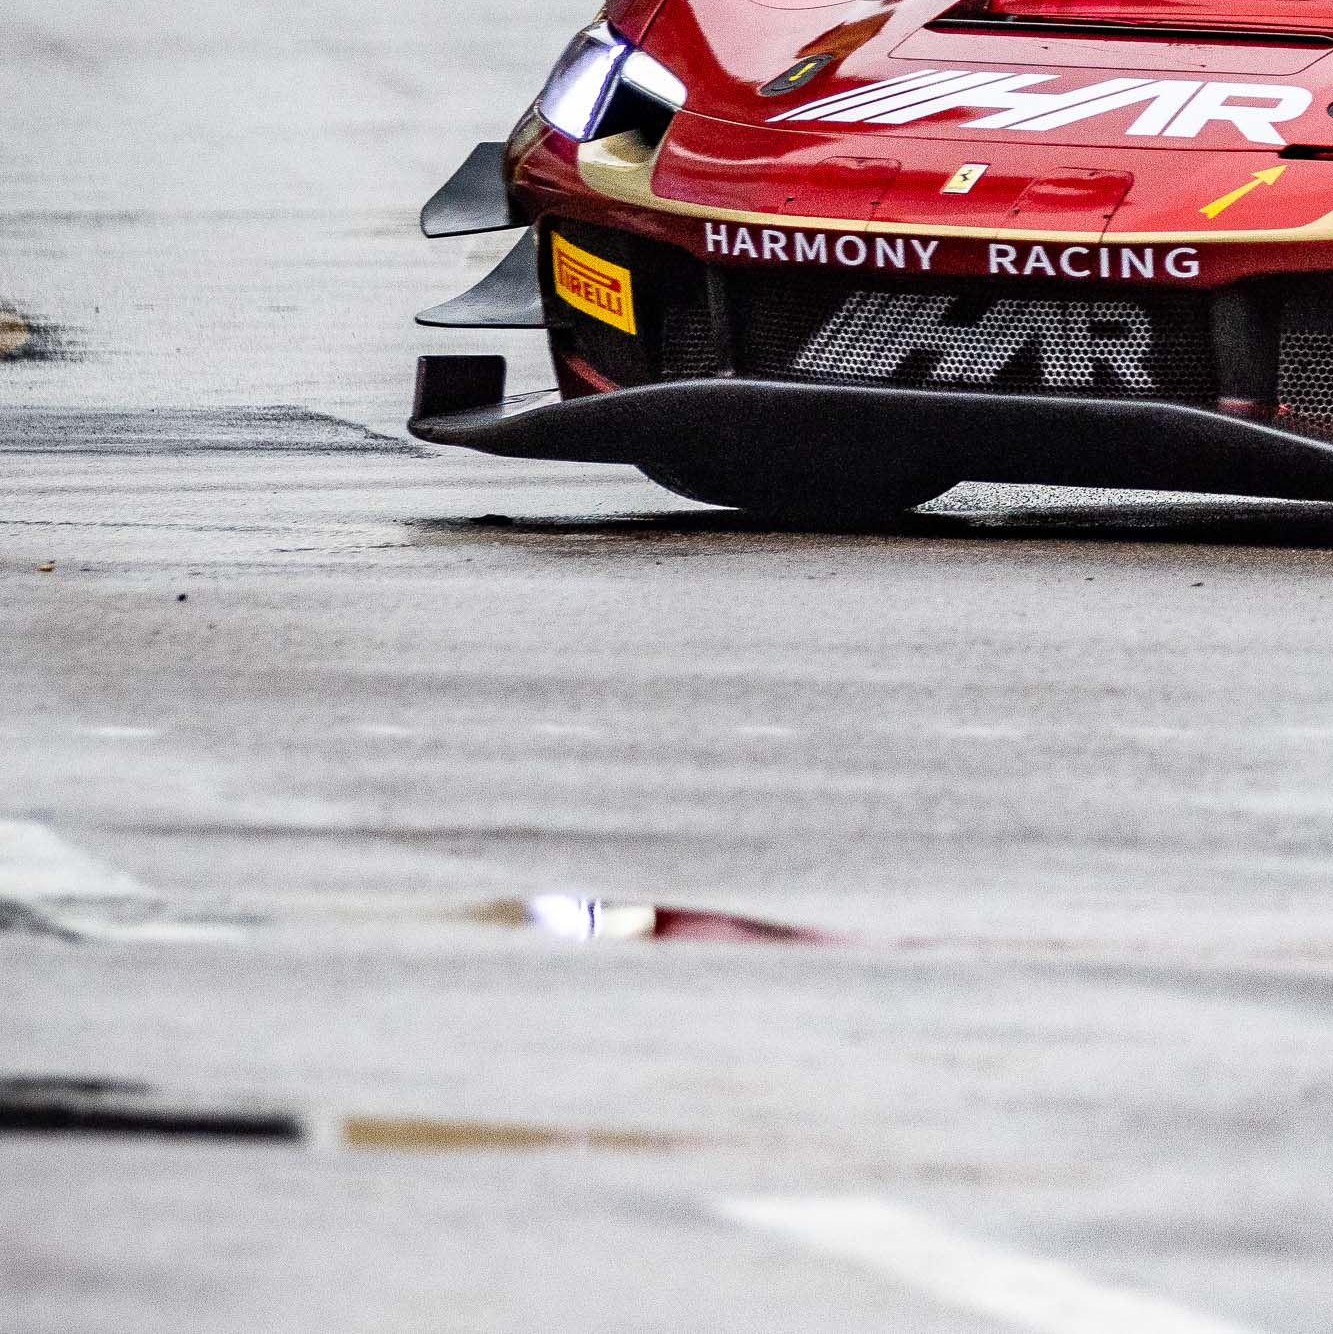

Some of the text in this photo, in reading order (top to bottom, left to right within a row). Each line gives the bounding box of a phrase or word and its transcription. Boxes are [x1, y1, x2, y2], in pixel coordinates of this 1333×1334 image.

[704, 222, 1200, 279] HARMONY RACING
[557, 248, 624, 317] PIRELLI
